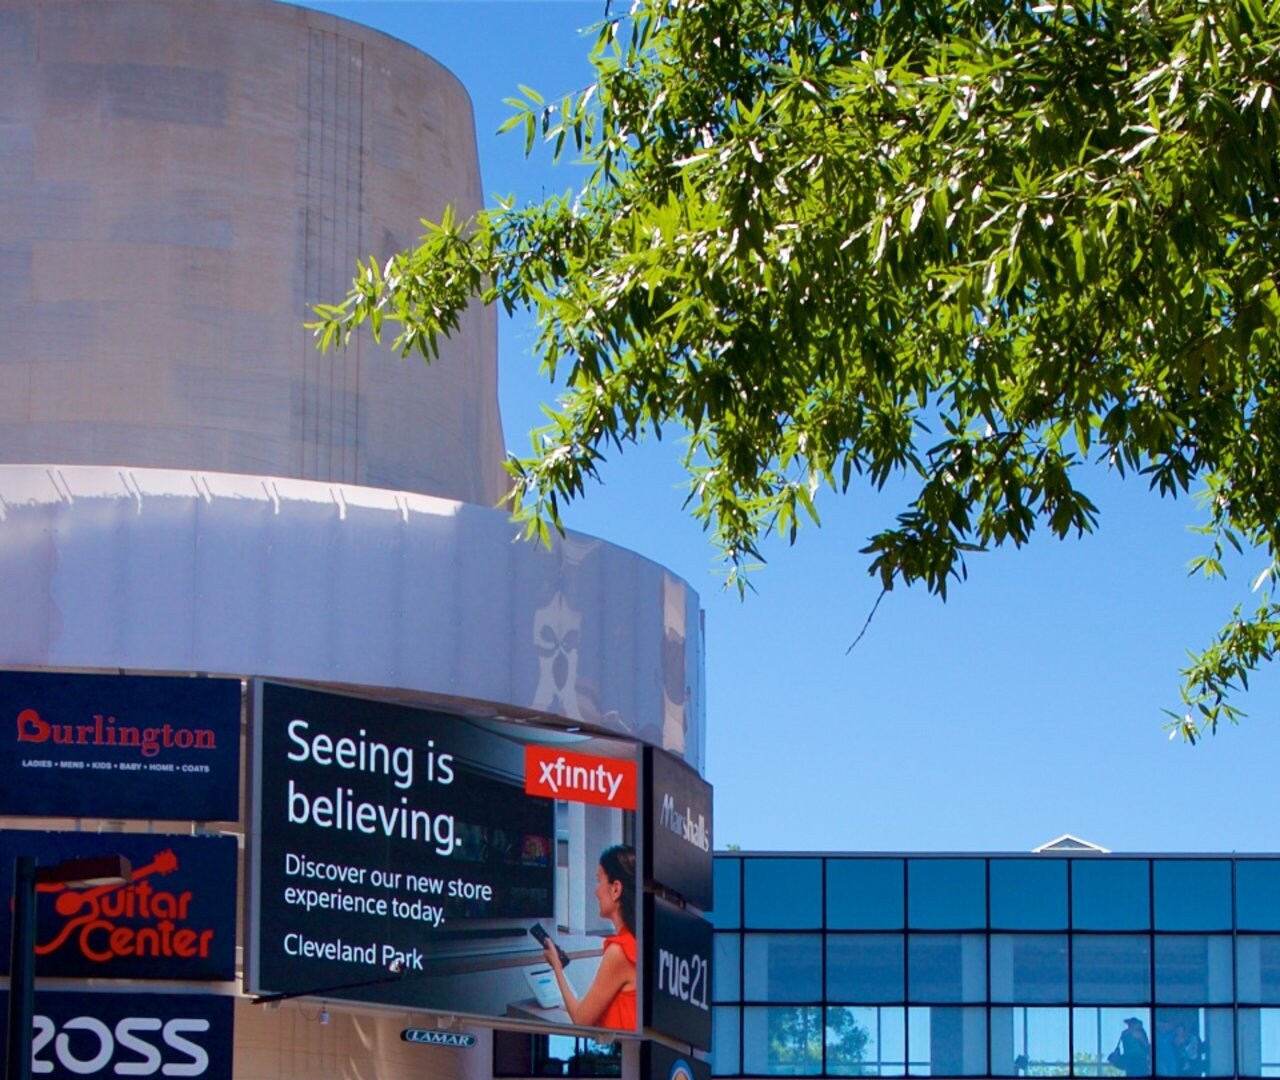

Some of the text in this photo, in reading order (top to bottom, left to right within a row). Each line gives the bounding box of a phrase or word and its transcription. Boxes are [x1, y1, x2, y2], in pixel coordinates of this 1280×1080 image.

[17, 709, 216, 757] Burlington
[287, 720, 454, 789] Seeing is
[22, 760, 210, 773] LADIES MENS KIDS BABY HOME COATS
[539, 757, 623, 800] xfinity
[288, 780, 462, 856] believing.
[660, 794, 709, 852] Marshalls
[285, 853, 492, 901] Discover our new store
[284, 887, 445, 927] experience today.
[80, 919, 213, 961] Center
[284, 933, 423, 971] Cleveland Park
[658, 948, 709, 1011] rue21
[412, 1031, 469, 1046] LAMAR
